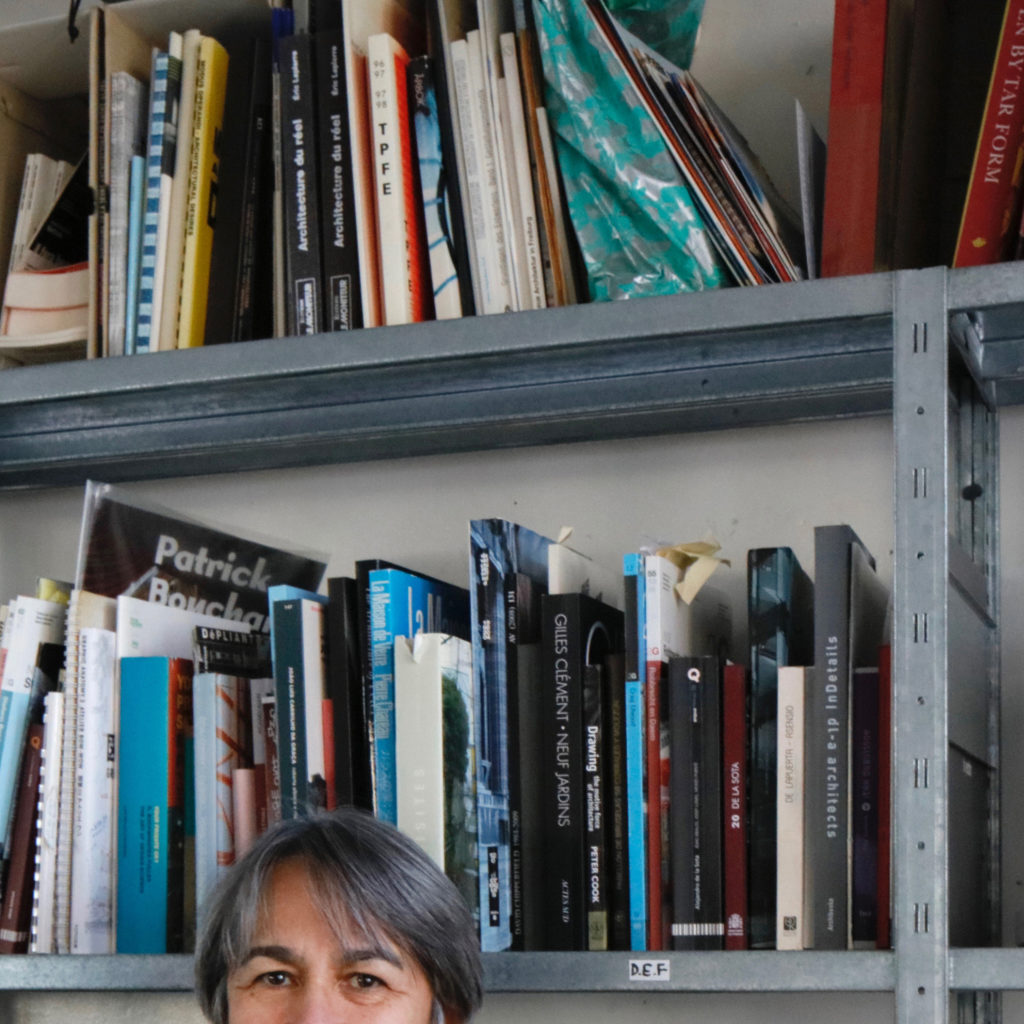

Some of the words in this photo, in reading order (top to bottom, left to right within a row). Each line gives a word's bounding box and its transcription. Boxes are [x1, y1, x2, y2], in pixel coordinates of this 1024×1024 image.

[1008, 44, 1024, 71] BY
[997, 75, 1021, 116] TAR
[292, 118, 304, 146] réel
[330, 114, 342, 141] réel
[293, 148, 305, 166] du
[331, 144, 342, 162] du
[983, 124, 1011, 184] FORM
[294, 169, 310, 252] Architecture
[332, 165, 345, 248] Architecture
[154, 533, 273, 592] Patrick
[371, 592, 391, 629] Maison
[373, 629, 392, 641] de
[554, 613, 569, 655] GILLES
[825, 636, 839, 710] InDetails
[554, 657, 571, 722] CLÉMENT
[555, 733, 570, 769] NEUF
[585, 725, 600, 772] Drawing
[593, 775, 601, 787] the
[731, 761, 740, 784] SOTA
[555, 771, 571, 827] JARDINS
[731, 785, 740, 796] LA
[731, 797, 740, 810] DE
[783, 792, 793, 803] DE
[826, 756, 839, 839] architects
[594, 812, 602, 829] force
[731, 814, 740, 829] 20
[590, 845, 600, 874] PETER
[591, 875, 600, 903] COOK
